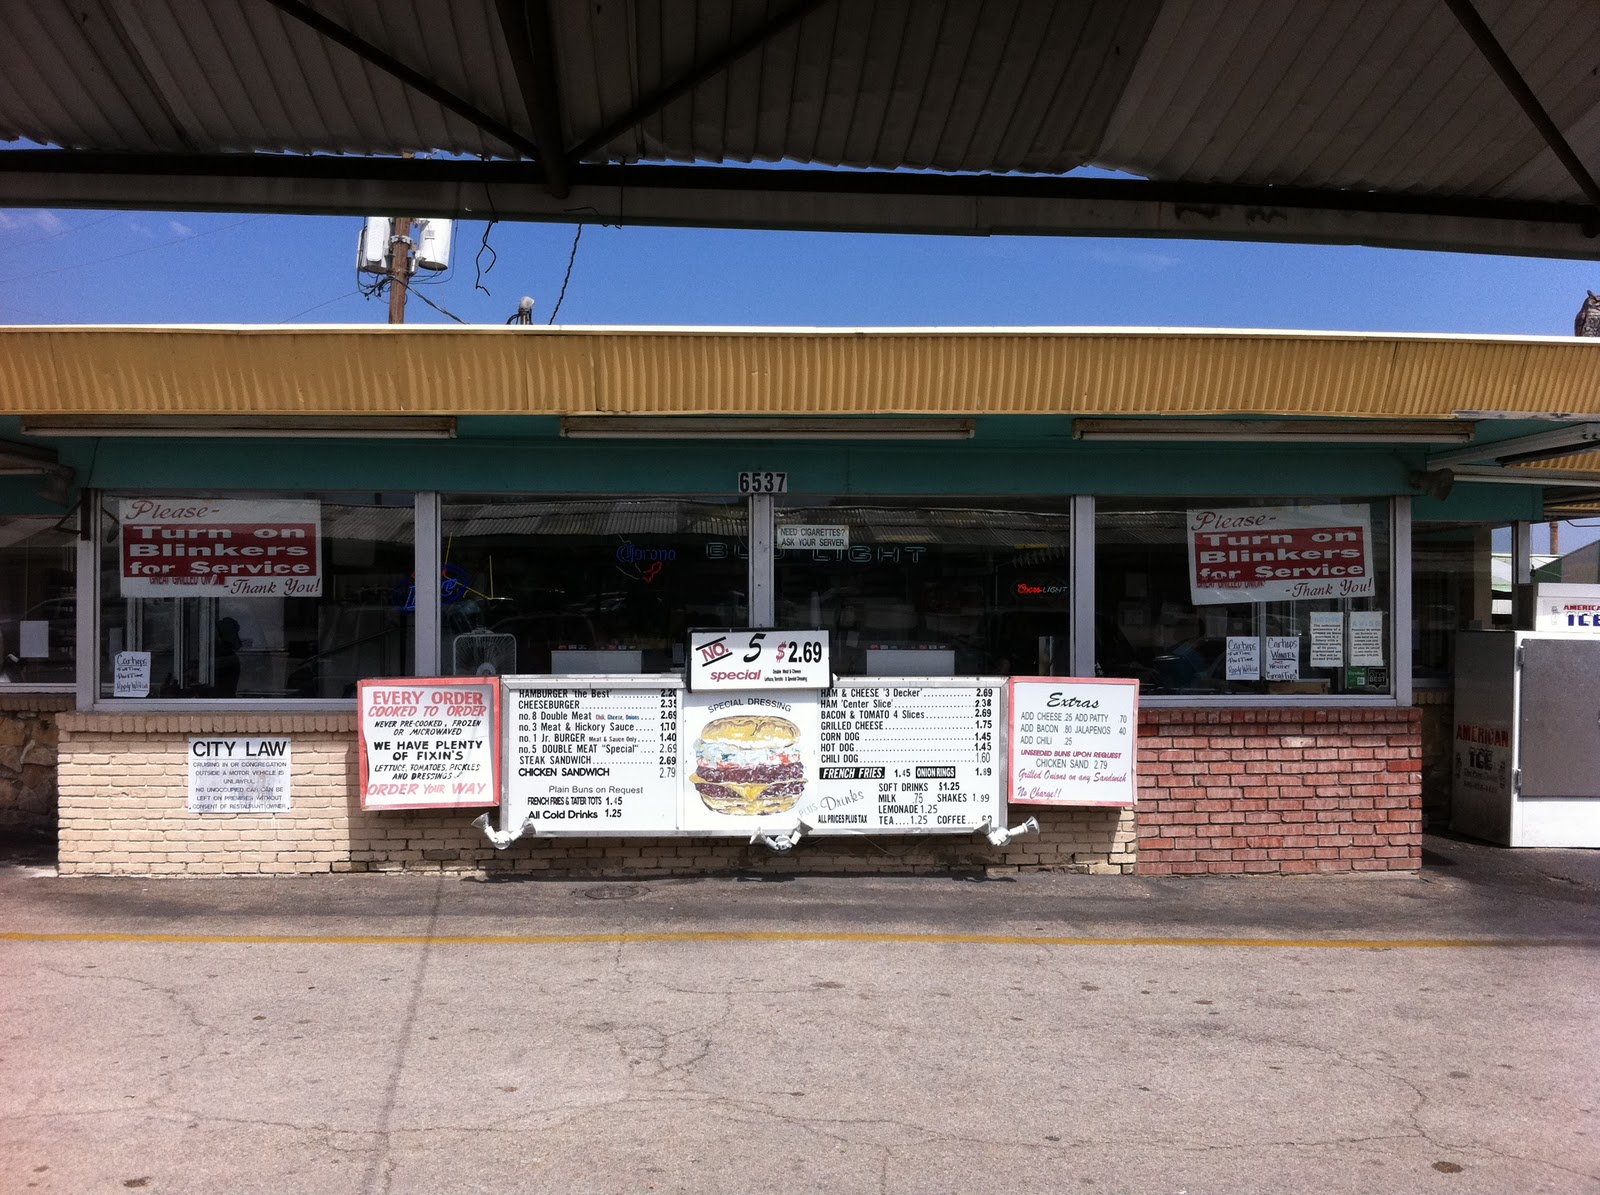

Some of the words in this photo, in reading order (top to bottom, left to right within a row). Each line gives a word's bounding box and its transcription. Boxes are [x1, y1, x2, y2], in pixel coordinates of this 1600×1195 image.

[739, 473, 785, 492] 6537
[133, 526, 232, 538] Turn
[254, 529, 305, 538] on
[780, 528, 797, 536] NEED
[801, 528, 845, 537] CIGARETTES?
[1202, 534, 1293, 546] Turn
[1311, 532, 1357, 542] on
[129, 544, 309, 556] Blinkers
[813, 545, 928, 563] LIGHT
[1199, 548, 1361, 563] Blinkers
[130, 562, 176, 575] for
[190, 561, 310, 574] Service
[1199, 568, 1241, 579] for
[1254, 564, 1363, 578] Service
[285, 578, 320, 595] You!
[1340, 578, 1372, 596] You!
[702, 643, 728, 661] NO.
[743, 633, 766, 662] 5
[776, 641, 822, 663] $2.69
[711, 670, 761, 682] special
[373, 691, 424, 705] EVERY
[432, 691, 483, 705] ORDER
[519, 689, 568, 698] HAMBURGER
[821, 689, 838, 697] HAM
[851, 689, 879, 697] CHEESE
[976, 689, 992, 697] 2.69
[518, 700, 579, 709] CHEESEBURGER
[708, 699, 744, 713] SPECIAL
[747, 698, 791, 712] DRESSING
[821, 700, 837, 708] HAM
[975, 699, 991, 708] 2.38
[1047, 692, 1099, 708] Extras
[368, 706, 417, 717] COOKED
[423, 706, 439, 716] TO
[447, 706, 486, 716] ORDER
[541, 712, 568, 720] Double
[571, 712, 592, 720] Meat
[660, 711, 677, 720] 2.69
[821, 710, 846, 719] BACON
[860, 710, 889, 719] TOMATO
[894, 710, 898, 719] 4
[902, 710, 924, 718] Slices
[975, 709, 991, 717] 2.69
[1021, 712, 1034, 720] ADD
[1037, 713, 1062, 721] CHEESE
[1089, 714, 1108, 722] PATTY
[541, 723, 561, 731] Meat
[575, 723, 605, 733] Hickory
[610, 723, 634, 731] Sauce
[660, 722, 676, 731] 1.70
[821, 721, 852, 730] GRILLED
[855, 721, 883, 730] CHEESE
[975, 720, 992, 728] 1.75
[1021, 724, 1034, 732] ADD
[1037, 725, 1058, 733] BACON
[1075, 726, 1111, 734] JALAPENOS
[554, 734, 585, 742] BURGER
[660, 733, 677, 742] 1.40
[821, 733, 841, 741] CORN
[844, 733, 860, 741] DOG
[975, 733, 991, 741] 1.45
[1036, 737, 1052, 745] CHILI
[1456, 724, 1508, 748] AMERICAN
[193, 741, 236, 756] CITY
[246, 741, 287, 756] LAW
[374, 742, 390, 750] WE
[397, 741, 429, 750] HAVE
[436, 741, 483, 749] PLENTY
[542, 745, 572, 753] DOUBLE
[577, 745, 597, 753] MEAT
[659, 744, 677, 753] 2.69
[821, 743, 835, 752] HOT
[839, 743, 854, 752] DOG
[974, 743, 991, 751] 1.45
[393, 752, 408, 761] OF
[417, 750, 463, 760] FIXIN'S
[520, 756, 545, 764] STEAK
[550, 756, 591, 764] SANDWICH
[659, 756, 676, 765] 2.69
[821, 754, 840, 763] CHILI
[843, 754, 859, 763] DOG
[976, 752, 991, 762] 1.60
[1470, 746, 1493, 771] ICE
[1036, 759, 1066, 768] CHICKEN
[1094, 761, 1107, 769] 2.79
[518, 768, 557, 776] CHICKEN
[562, 768, 610, 776] SANDWICH
[659, 767, 676, 778] 2.79
[823, 768, 855, 778] FRENCH
[894, 769, 911, 777] 1.45
[917, 768, 936, 777] ONION
[936, 768, 954, 777] RINGS
[1018, 768, 1041, 781] Grilled
[1044, 770, 1067, 780] Onions
[1078, 775, 1091, 783] any
[1093, 772, 1126, 782] Sandwich
[368, 783, 419, 795] ORDER
[452, 783, 486, 794] WAY
[609, 786, 643, 794] Request
[879, 783, 897, 791] SOFT
[901, 783, 928, 791] DRINKS
[939, 782, 960, 790] $1.25
[1017, 786, 1027, 797] No
[528, 797, 549, 805] FRENCH
[550, 797, 564, 805] FRIES
[571, 797, 587, 805] TATER
[588, 797, 602, 805] TOTS
[606, 797, 622, 805] 1.45
[820, 789, 864, 810] Drinks
[878, 794, 896, 802] MILK
[912, 793, 923, 803] .75
[937, 794, 967, 802] SHAKES
[973, 794, 989, 802] 1.99
[529, 811, 540, 819] All
[543, 811, 566, 819] Cold
[568, 810, 598, 819] Drinks
[605, 809, 622, 817] 1.25
[878, 805, 918, 814] LEMONADE
[920, 804, 938, 813] 1.25
[818, 815, 827, 823] ALL
[828, 815, 845, 823] PRICES
[845, 815, 858, 823] PLUS
[858, 815, 868, 823] TAX
[910, 815, 928, 824] 1.25
